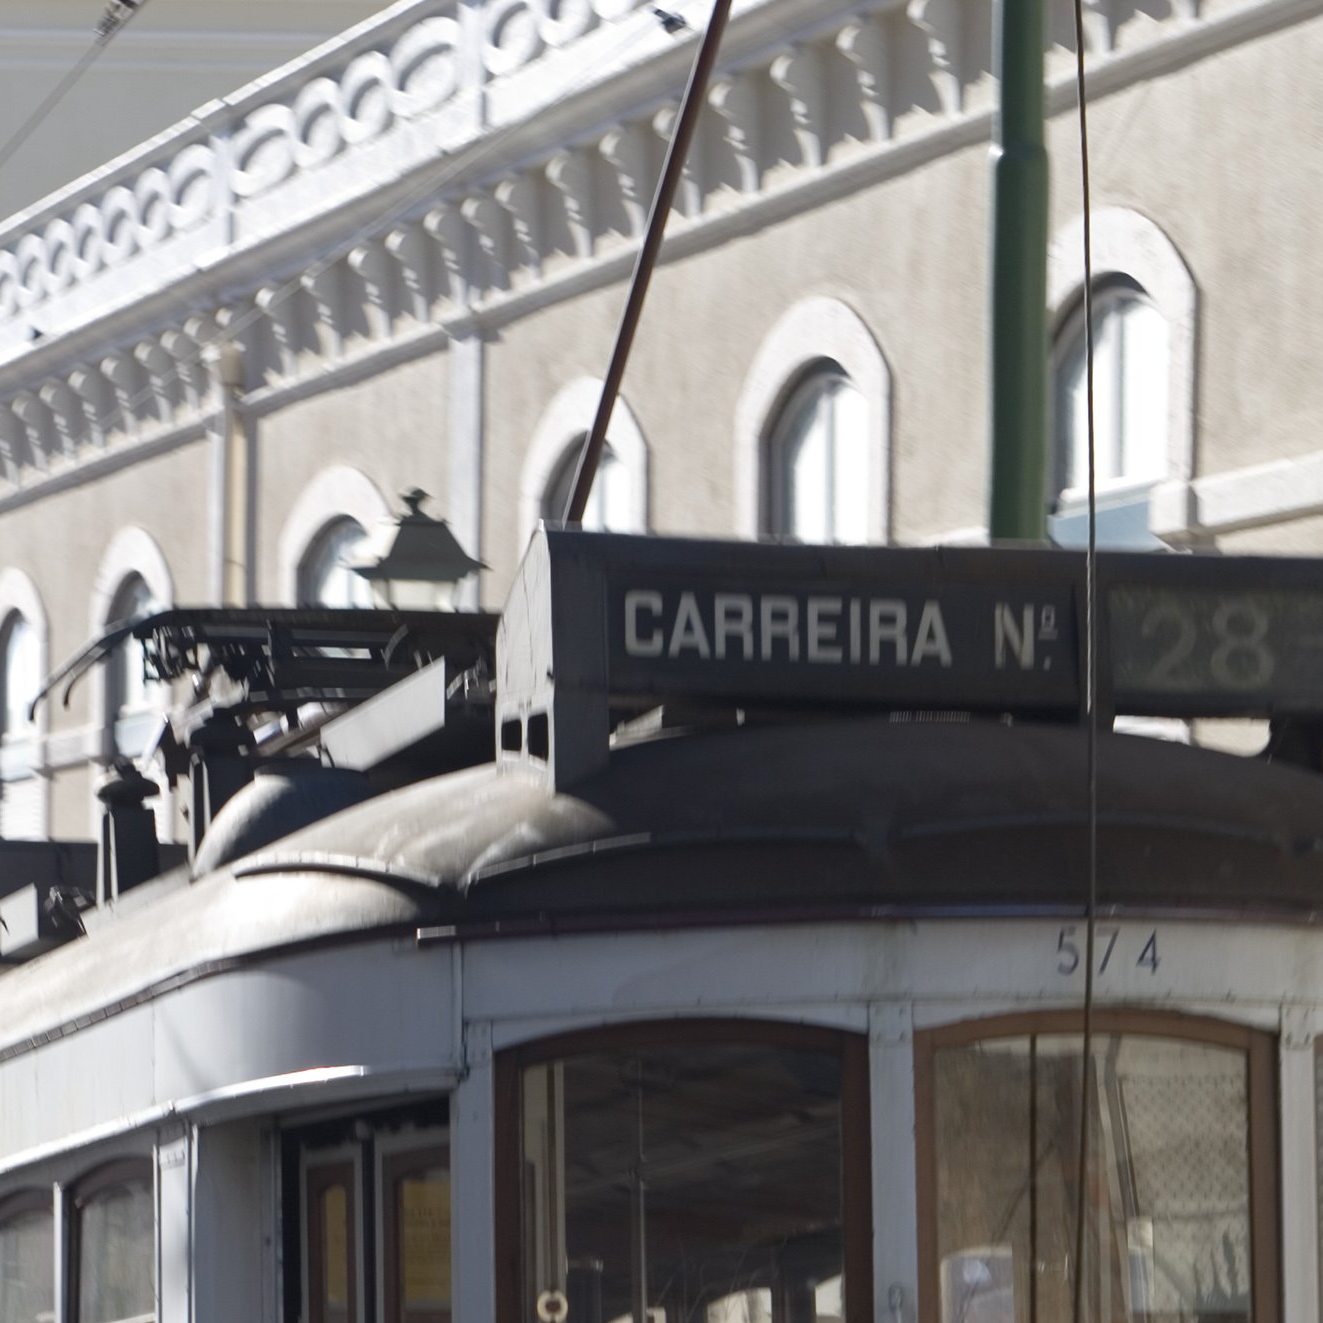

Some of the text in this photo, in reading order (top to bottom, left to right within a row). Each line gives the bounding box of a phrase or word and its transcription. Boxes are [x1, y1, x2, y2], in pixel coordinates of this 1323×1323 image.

[624, 589, 953, 668] CARREIRA
[1140, 598, 1276, 691] 28
[1057, 926, 1161, 976] 574
